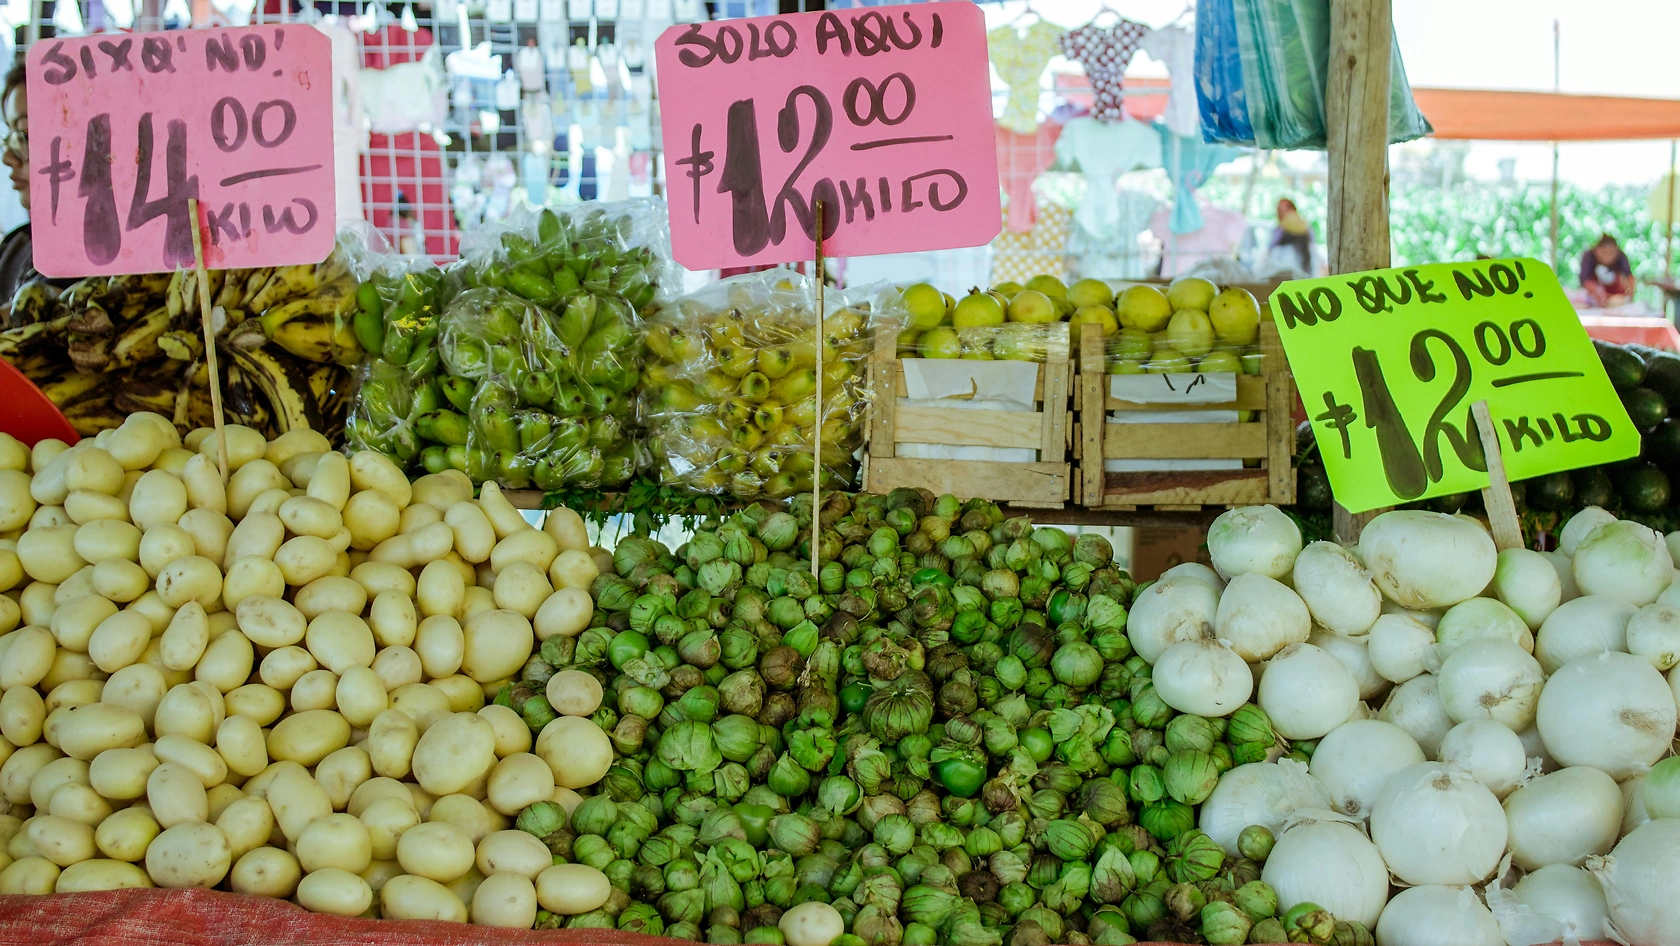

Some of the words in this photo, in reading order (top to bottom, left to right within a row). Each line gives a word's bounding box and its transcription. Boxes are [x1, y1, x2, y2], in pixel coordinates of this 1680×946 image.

[205, 28, 286, 77] NO!
[674, 20, 799, 68] SOLO
[815, 11, 944, 57] AQUI
[839, 169, 969, 224] KILO
[1276, 286, 1343, 329] NO
[1347, 269, 1447, 314] QUE
[1451, 261, 1534, 301] NO!
[1502, 412, 1613, 453] KILO
